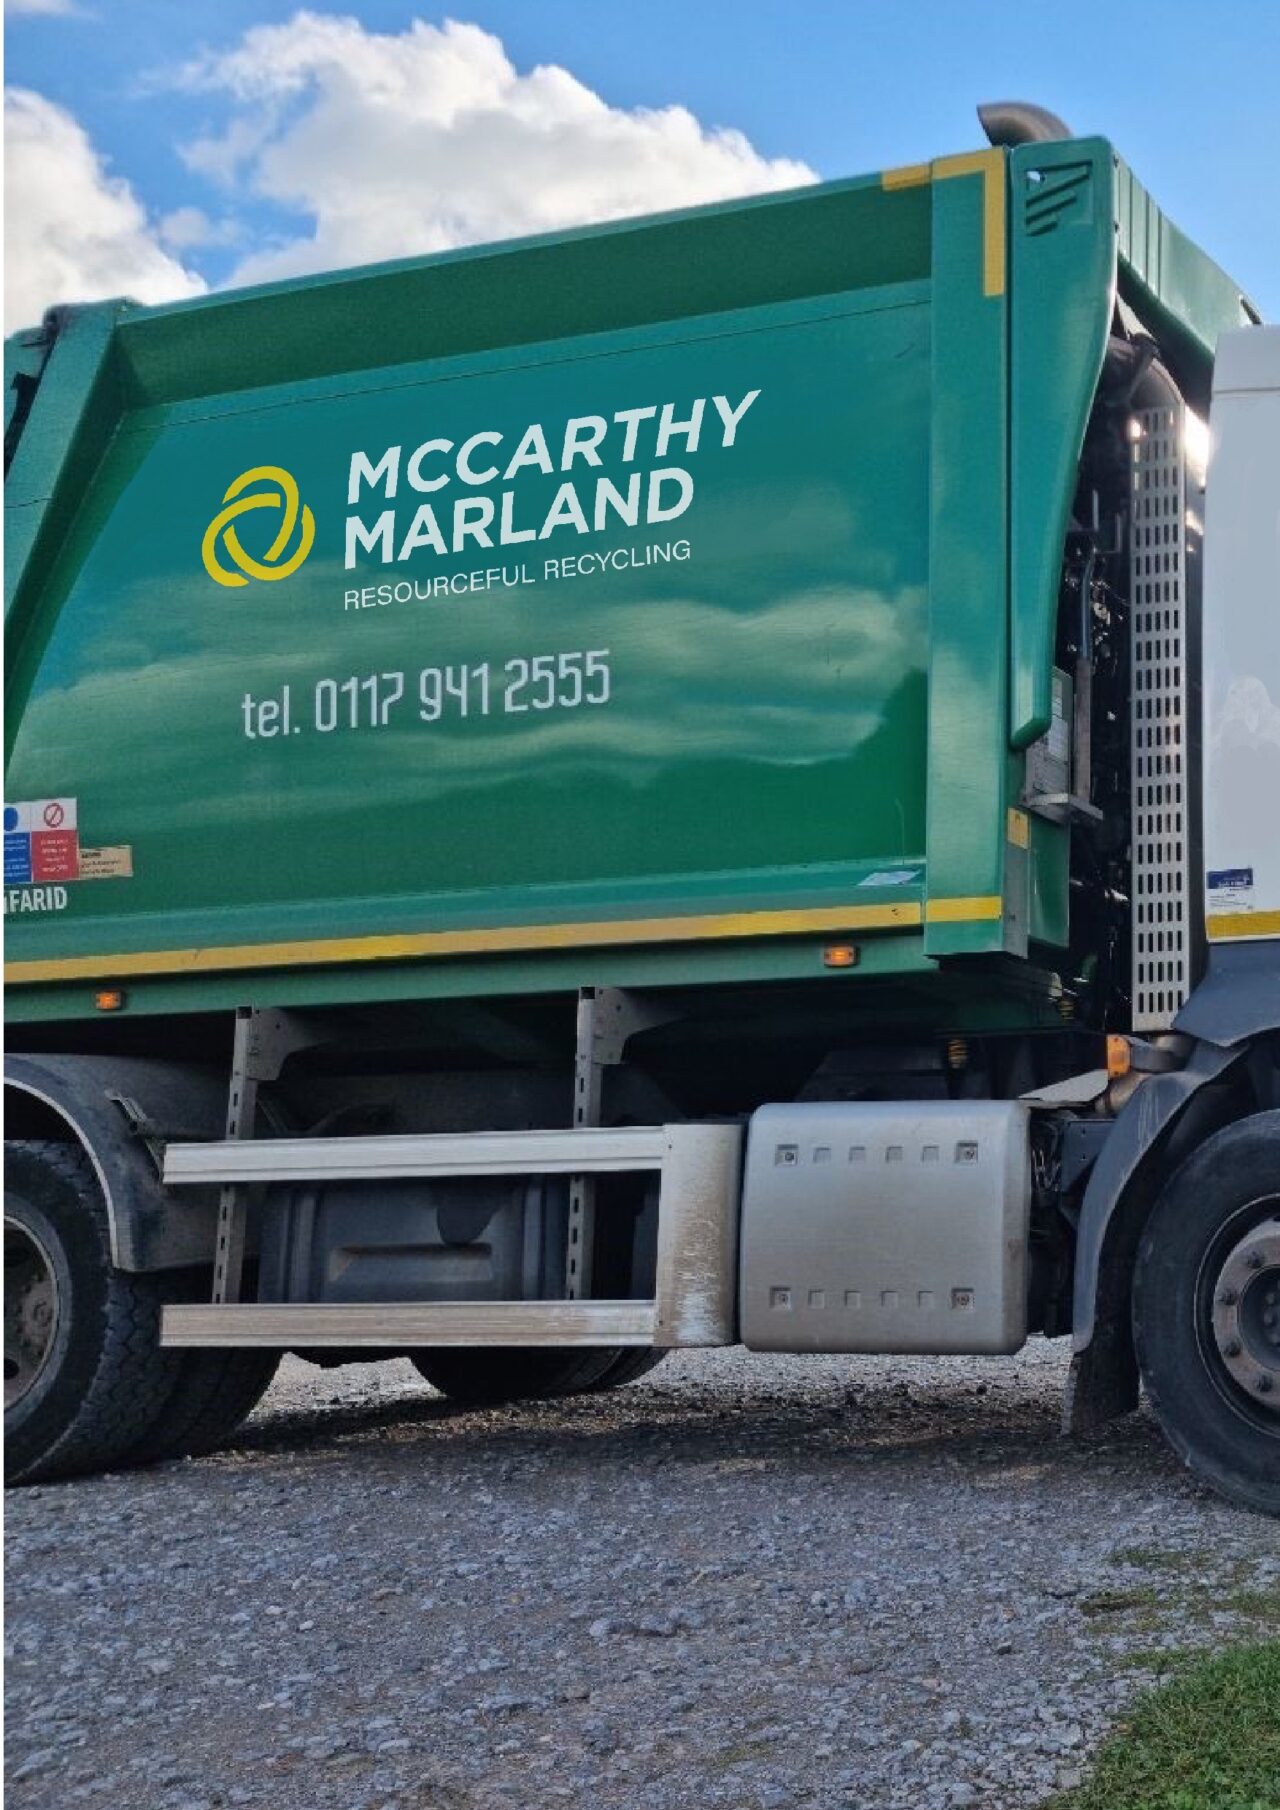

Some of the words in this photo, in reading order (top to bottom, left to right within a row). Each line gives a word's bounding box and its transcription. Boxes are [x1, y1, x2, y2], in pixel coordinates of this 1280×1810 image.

[347, 389, 762, 505] MCCARTHY
[345, 467, 694, 570] MARLAND
[344, 565, 536, 611] RESOURCEFUL
[545, 540, 691, 581] RECYCLING
[240, 684, 300, 740] tel.
[315, 671, 404, 732] 0117
[419, 662, 490, 722] 941
[504, 647, 611, 713] 2555
